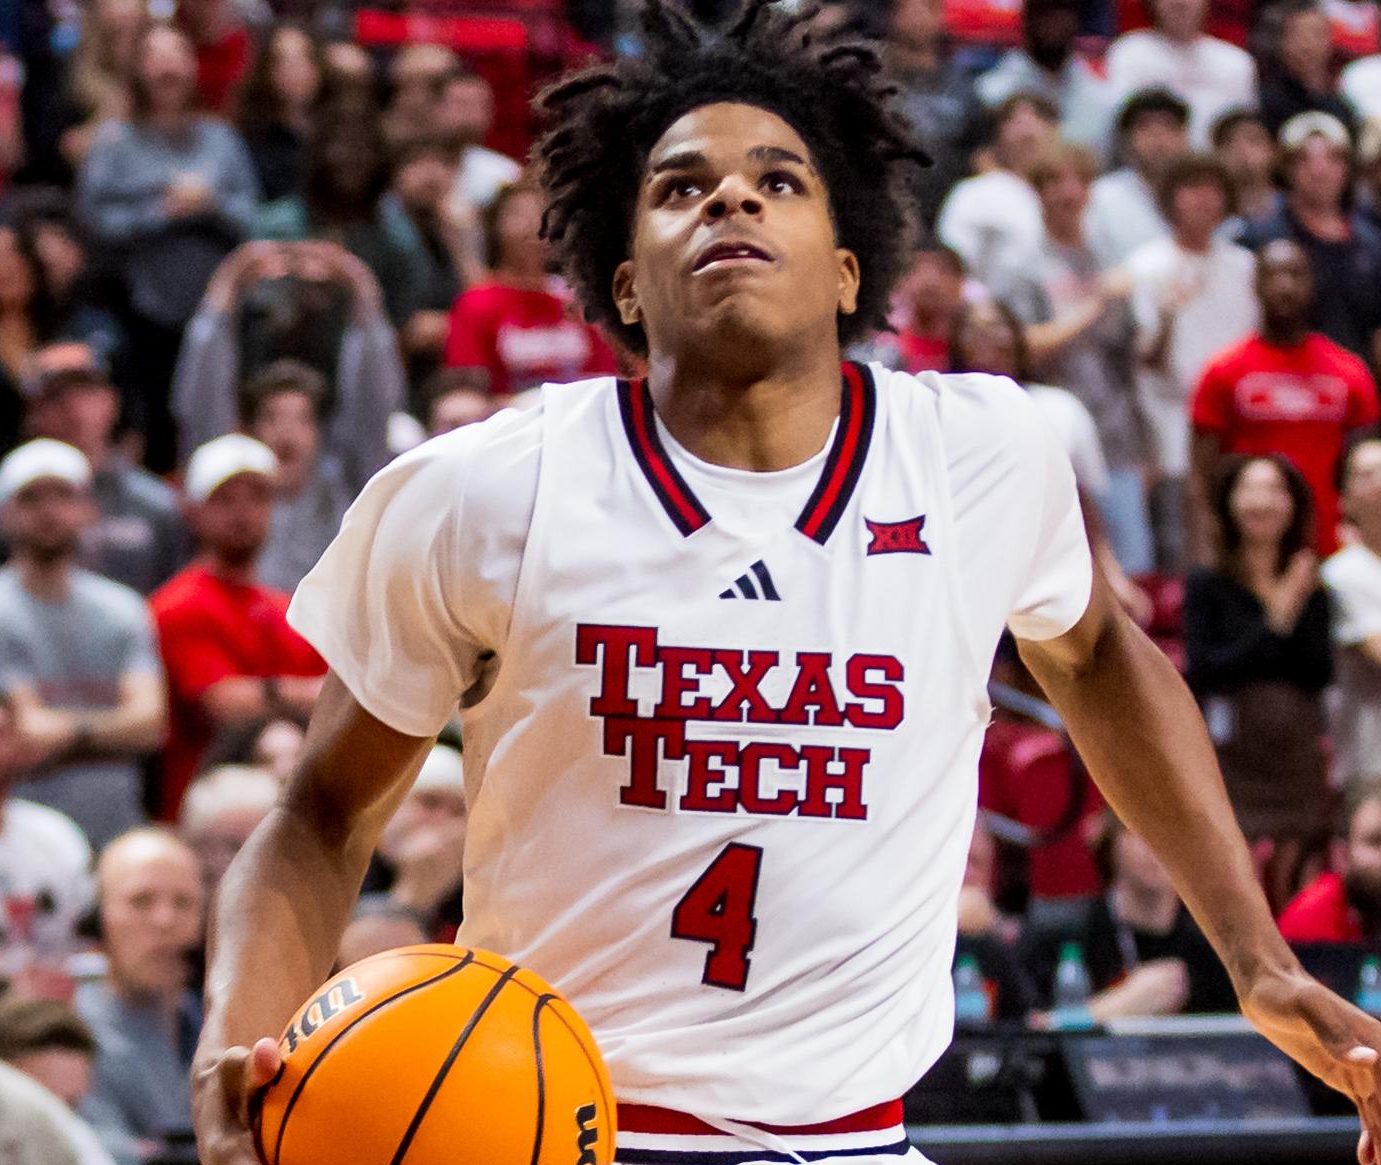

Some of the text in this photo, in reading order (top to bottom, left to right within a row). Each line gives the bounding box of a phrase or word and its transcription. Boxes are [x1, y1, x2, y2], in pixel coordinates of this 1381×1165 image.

[574, 623, 905, 731] TEXAS
[603, 716, 872, 820] TECH
[671, 841, 764, 992] 4
